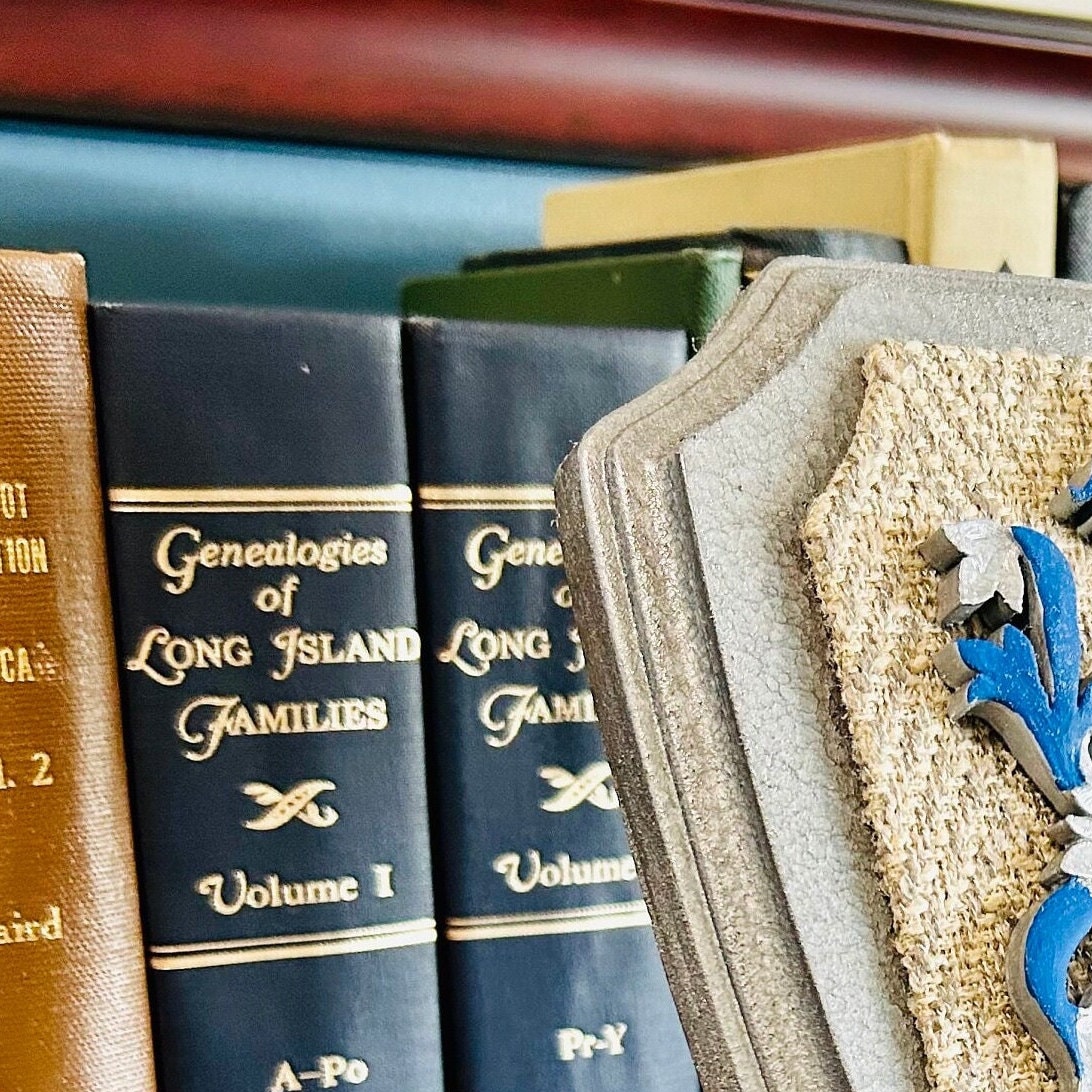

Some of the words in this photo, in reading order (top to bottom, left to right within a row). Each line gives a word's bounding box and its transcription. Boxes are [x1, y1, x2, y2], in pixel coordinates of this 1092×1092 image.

[0, 537, 48, 574] ION
[155, 524, 388, 593] Genealogies
[255, 575, 298, 616] of
[127, 626, 252, 685] LONG
[271, 627, 421, 680] ISLAND
[439, 618, 551, 676] LONG
[175, 695, 388, 761] FAMILIES
[479, 683, 599, 748] FAMI
[31, 751, 54, 786] 2
[196, 870, 358, 915] Volume
[375, 864, 395, 898] I
[493, 849, 637, 893] Volume
[556, 1023, 627, 1060] Pr-Y
